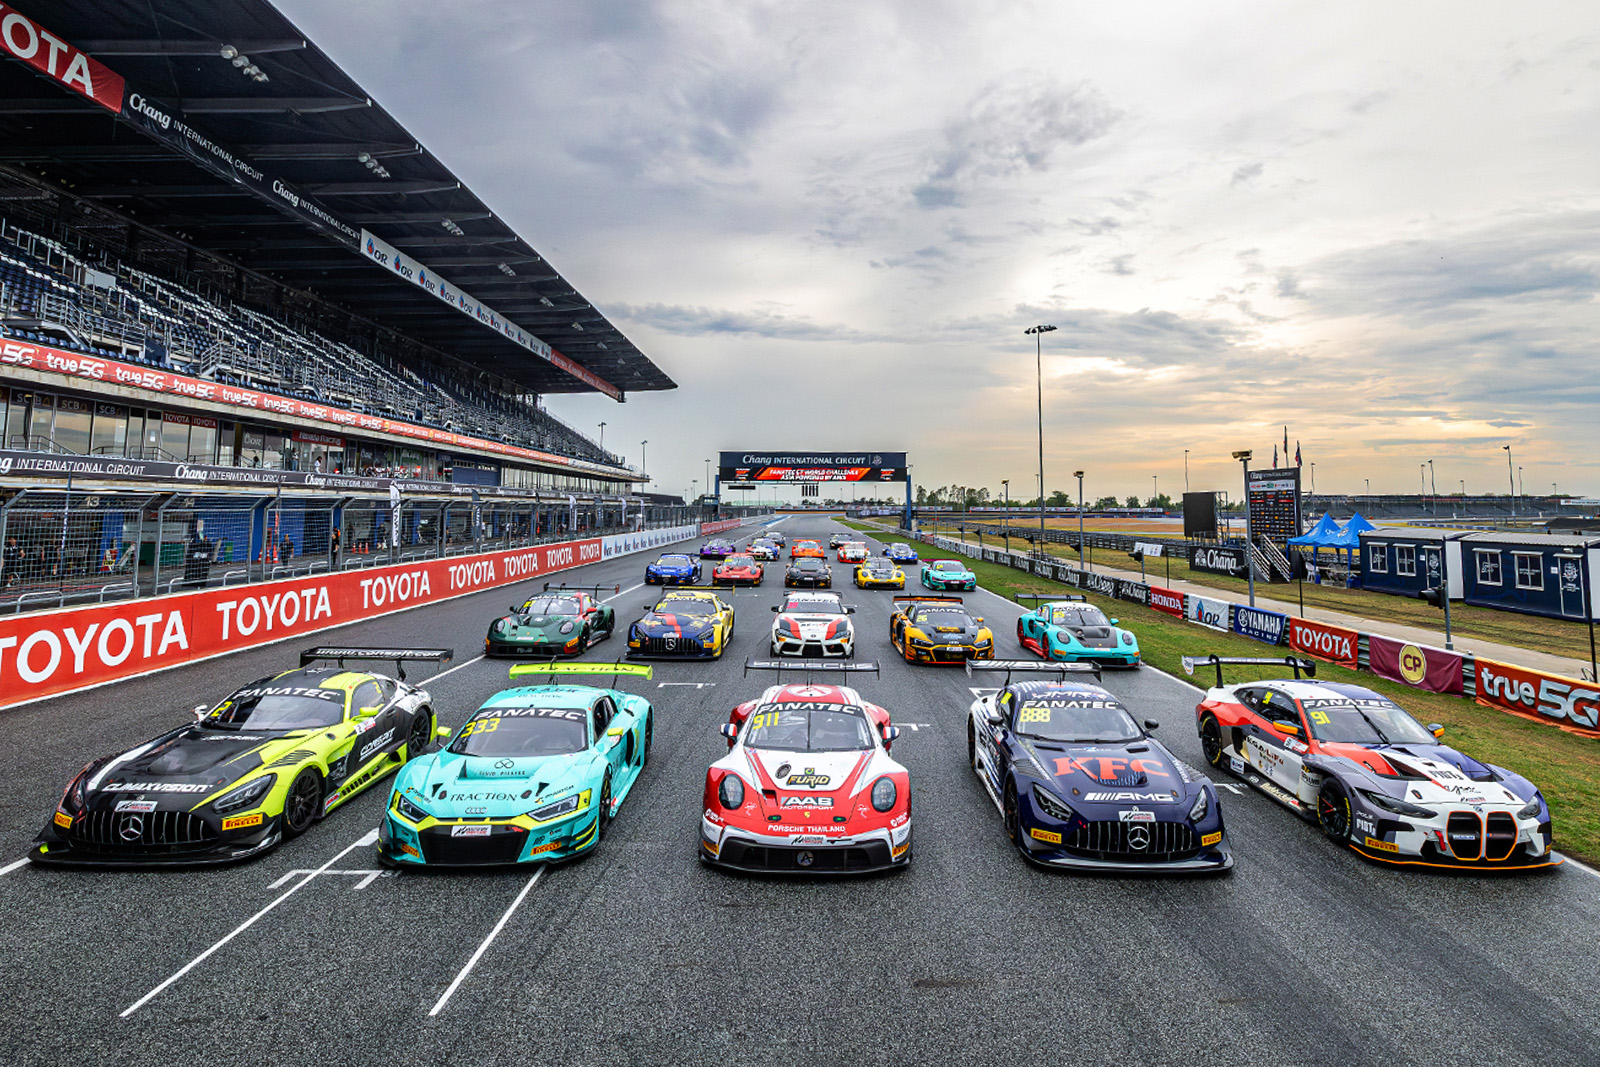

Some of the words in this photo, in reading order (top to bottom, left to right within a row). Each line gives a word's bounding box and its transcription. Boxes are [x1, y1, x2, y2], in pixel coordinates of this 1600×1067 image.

[0, 2, 95, 98] OTA
[129, 93, 171, 129] Chang
[173, 120, 234, 164] INTERNATIONAL
[234, 159, 264, 181] CIRCUIT
[272, 179, 299, 207] Chang
[374, 249, 388, 265] OR
[401, 265, 413, 279] OR
[425, 279, 435, 292] OR
[0, 343, 35, 365] 5G
[61, 400, 80, 410] SCB
[99, 405, 116, 415] SCB
[164, 413, 190, 424] TOYOTA
[193, 417, 216, 428] TOYOTA
[16, 458, 103, 473] INTERNATIONAL
[106, 463, 146, 475] CIRCUIT
[742, 455, 771, 465] Chang
[175, 465, 208, 483] Chang
[208, 471, 260, 481] INTERNATIONAL
[304, 473, 326, 489] Chang
[85, 496, 100, 507] 13
[547, 547, 573, 568] TOYOTA
[580, 542, 600, 561] TOYOTA
[504, 552, 539, 577] TOYOTA
[1207, 550, 1237, 570] Chang
[448, 560, 495, 590] TOYOTA
[360, 570, 431, 609] TOYOTA
[1128, 583, 1147, 603] Chang
[1151, 593, 1182, 611] HONDA
[216, 586, 332, 640] TOYOTA
[1204, 612, 1220, 627] OR
[1248, 611, 1281, 634] YAMAHA
[1241, 627, 1278, 641] RACING
[0, 610, 189, 684] TOYOTA
[1294, 626, 1352, 659] TOYOTA
[754, 661, 873, 669] PORSCHE
[1403, 654, 1421, 673] CP
[233, 687, 338, 700] FANATEC
[211, 701, 232, 717] 2
[758, 702, 857, 714] FANATEC
[1023, 701, 1117, 709] FANATEC
[1304, 700, 1394, 709] FANATEC
[474, 708, 582, 721] FANATEC
[753, 712, 779, 730] 911
[1020, 708, 1051, 722] 888
[1310, 711, 1331, 725] 91
[461, 718, 501, 738] 333
[1053, 757, 1169, 780] KFC
[788, 775, 829, 787] FURIO
[450, 793, 518, 802] TRACTION
[784, 797, 834, 806] AAS
[1114, 793, 1174, 801] AMG
[224, 816, 260, 828] PIRELLI
[768, 824, 804, 833] PORSCHE
